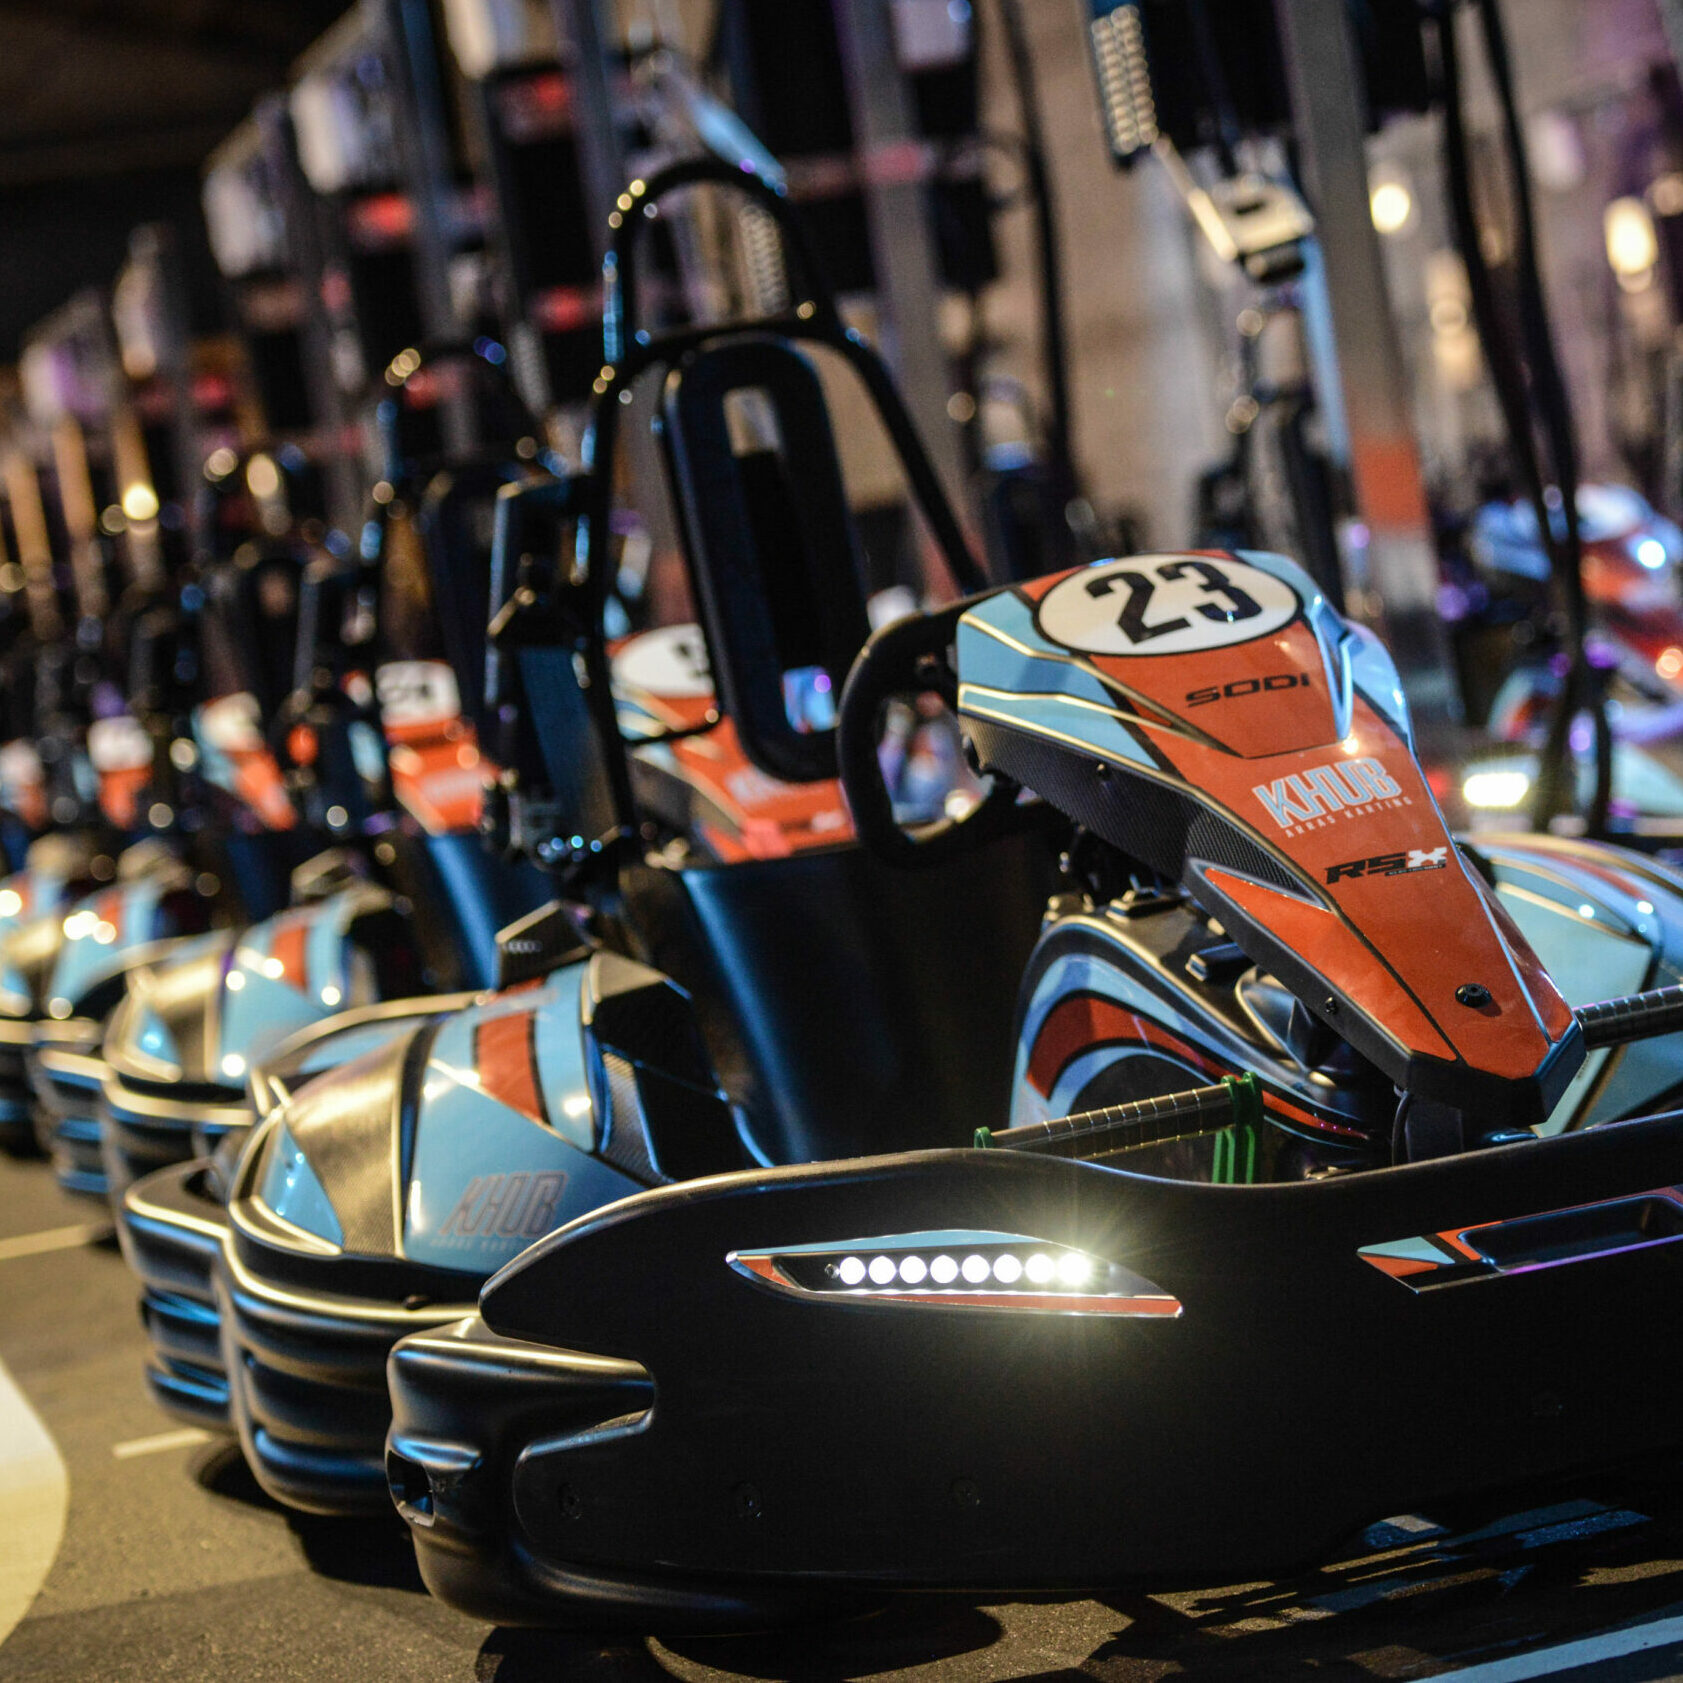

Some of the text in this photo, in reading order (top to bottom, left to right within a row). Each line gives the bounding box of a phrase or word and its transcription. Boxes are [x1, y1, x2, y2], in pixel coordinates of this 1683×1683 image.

[1085, 561, 1263, 644] 23
[1185, 672, 1310, 708] SODI
[1252, 757, 1402, 828] KHUB
[1285, 796, 1412, 838] ARRAS KARTING
[1324, 847, 1447, 885] RSX
[438, 1170, 568, 1238] KHUB
